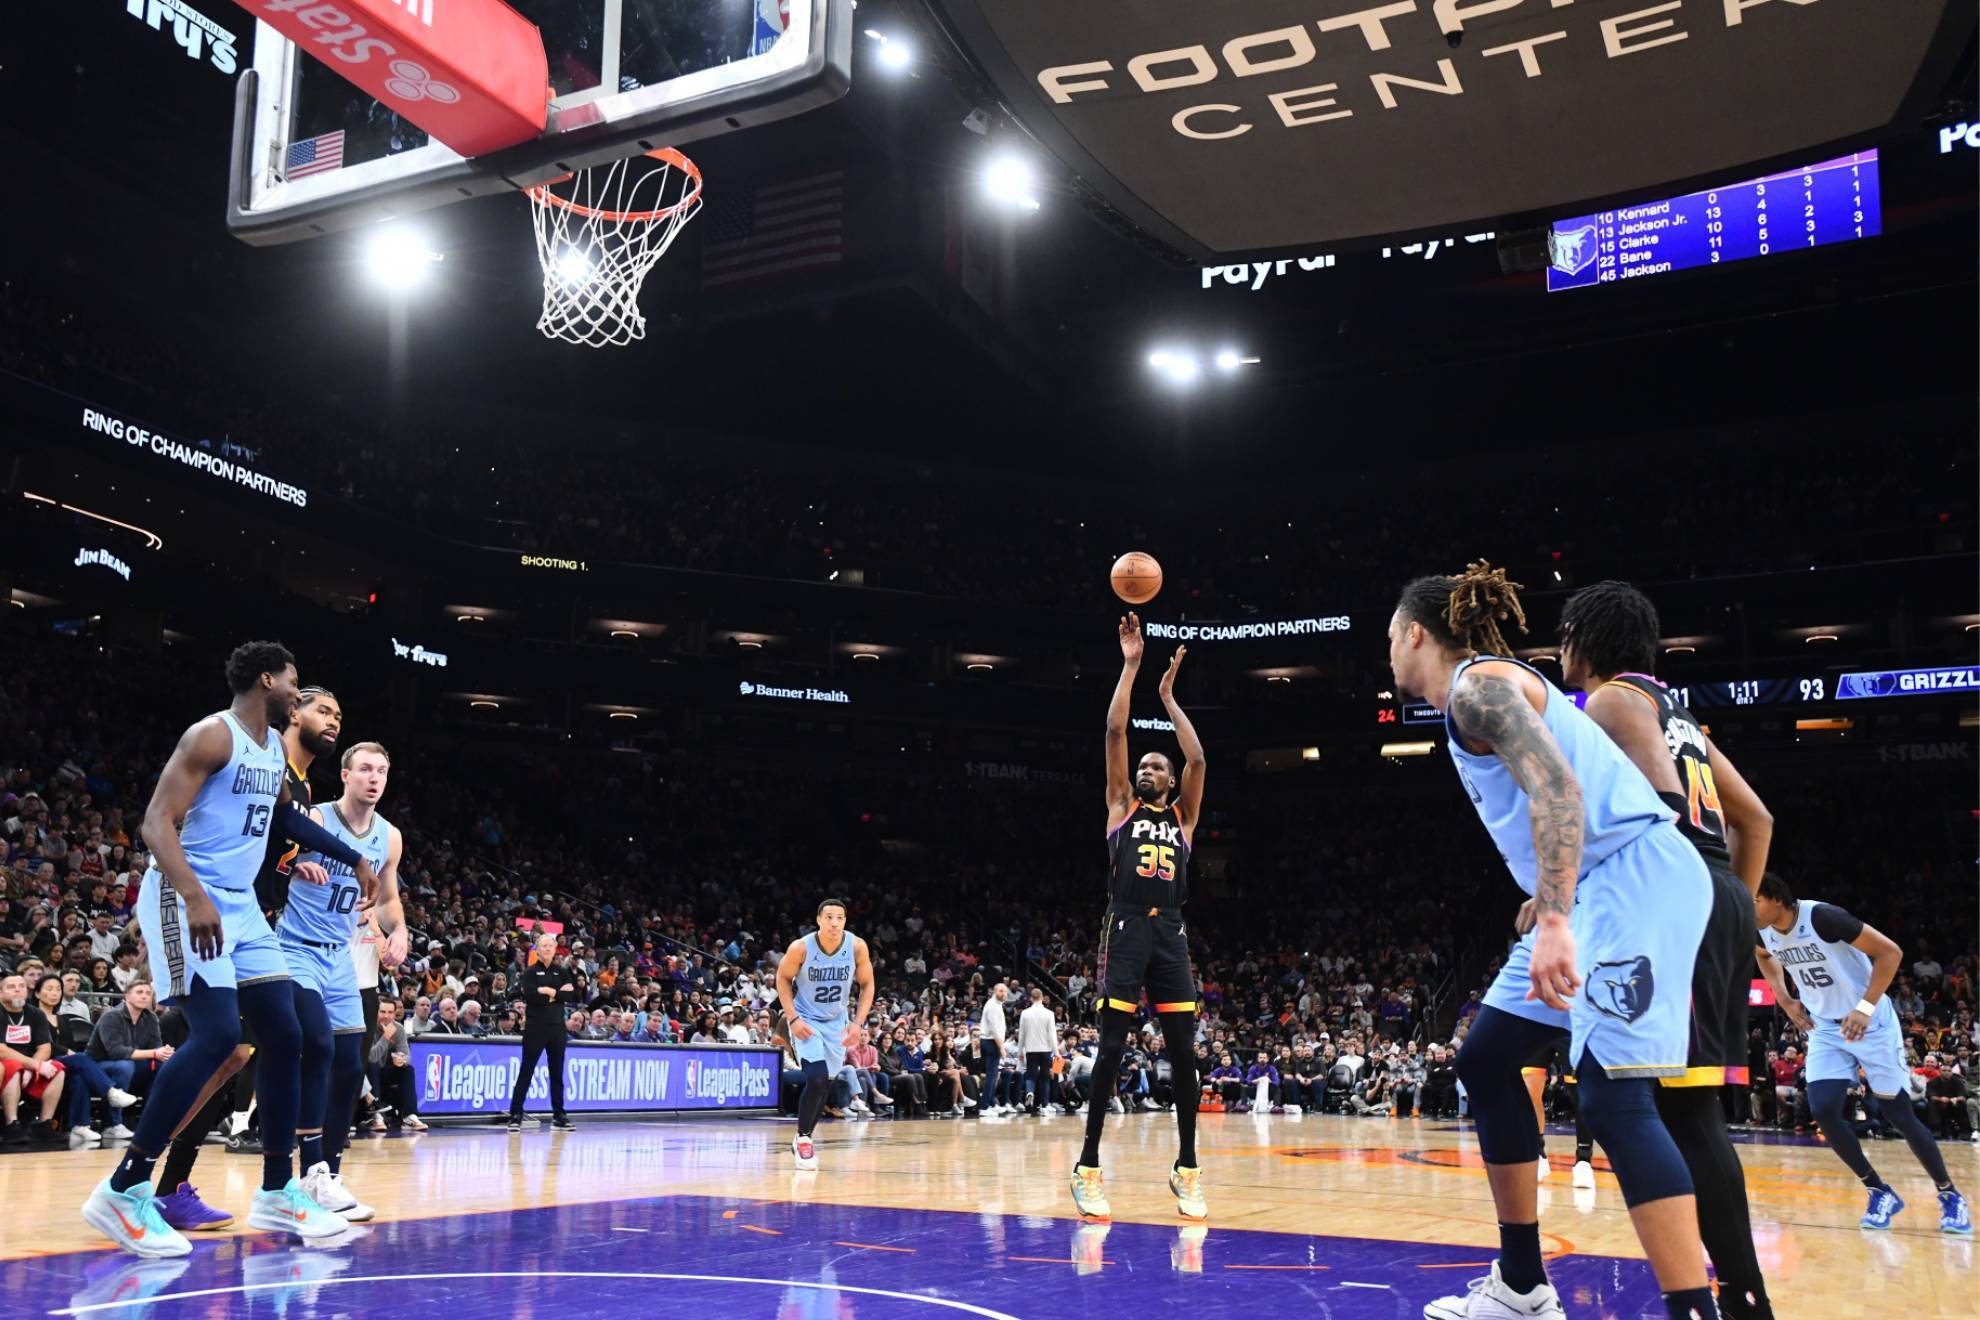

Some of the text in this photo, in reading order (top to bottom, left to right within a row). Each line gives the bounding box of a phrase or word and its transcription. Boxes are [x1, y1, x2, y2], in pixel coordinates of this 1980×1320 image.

[1037, 0, 1574, 104] FOOTP
[1599, 166, 1859, 225] 10 Kennard 0 3 3 1
[1600, 181, 1860, 239] 13 Jackson Jr. 13 4 1 1
[1600, 196, 1861, 253] 15 Clarke 10 6 2 1
[1600, 211, 1863, 268] 22 Bane 11 5 3 3
[1600, 226, 1862, 282] 45 Jackson 3 0 1 1
[82, 408, 307, 507] RING OF CHAMPION PARTNERS
[74, 547, 99, 567] JIM
[521, 555, 589, 571] SHOOTING 1.
[1146, 616, 1350, 640] RING OF CHAMPION PARTNERS
[756, 684, 849, 702] Banner Health
[1728, 681, 1758, 699] 1:11
[1800, 679, 1824, 701] 93
[1900, 670, 1980, 691] GRIZZL
[1378, 709, 1395, 723] 24
[232, 763, 281, 797] GRIZZLIE
[1681, 755, 1727, 840] 14
[241, 803, 270, 837] 13
[1132, 820, 1181, 847] PHX
[1136, 844, 1175, 881] 35
[327, 883, 359, 915] 10
[808, 965, 850, 982] GRIZZLIES
[1799, 966, 1834, 989] 45
[814, 985, 842, 1004] 22
[442, 1055, 770, 1109] League Pss STREAM NOW League Pass
